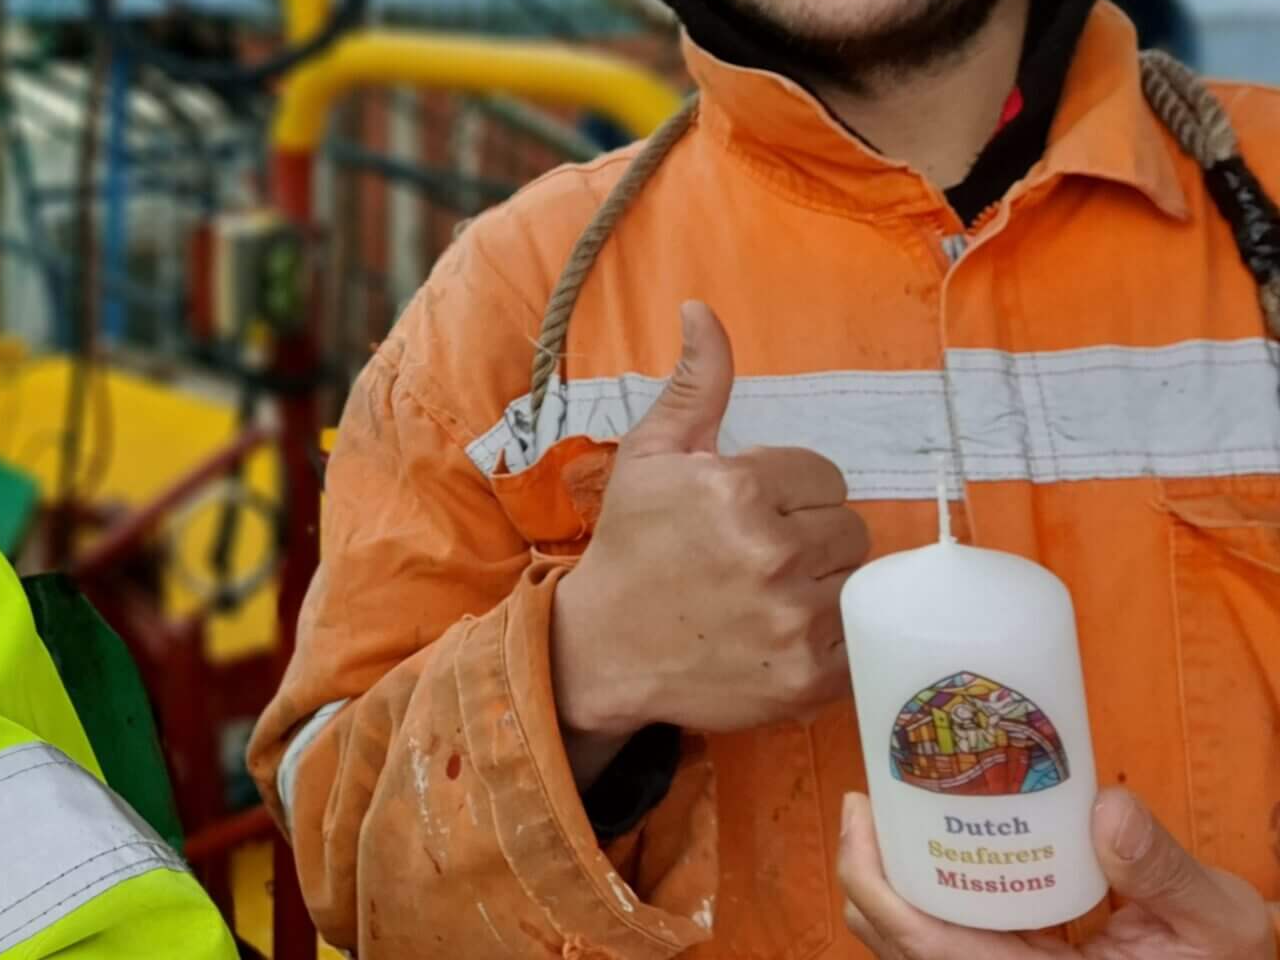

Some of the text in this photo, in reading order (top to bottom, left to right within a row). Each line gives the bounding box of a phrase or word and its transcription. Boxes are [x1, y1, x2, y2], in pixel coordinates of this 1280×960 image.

[943, 815, 1032, 837] Dutch
[927, 839, 1056, 865] Seafarers
[935, 867, 1057, 894] Missions
